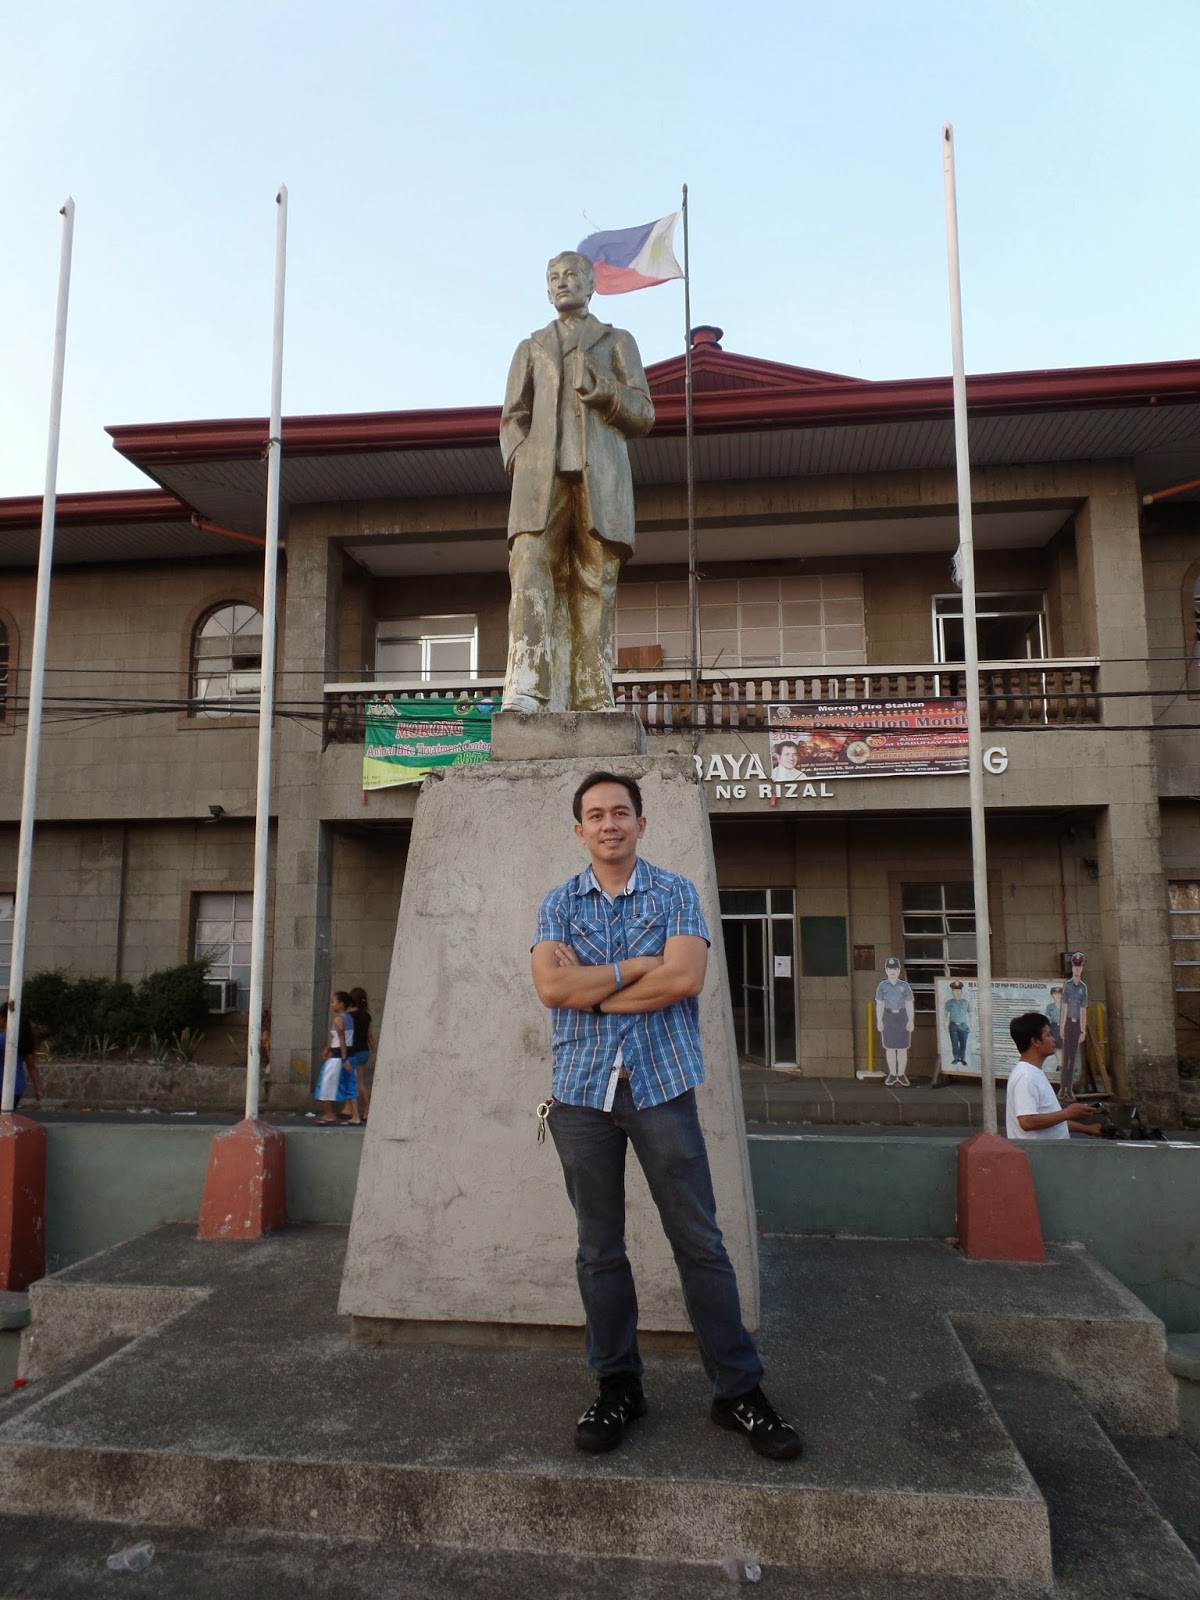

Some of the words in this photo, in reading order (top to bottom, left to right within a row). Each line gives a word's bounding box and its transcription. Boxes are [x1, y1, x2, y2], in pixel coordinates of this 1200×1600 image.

[395, 720, 464, 739] MORONG
[771, 732, 799, 740] 2015
[416, 742, 461, 755] Treatment
[716, 784, 746, 799] NG
[759, 783, 834, 799] RIZAL
